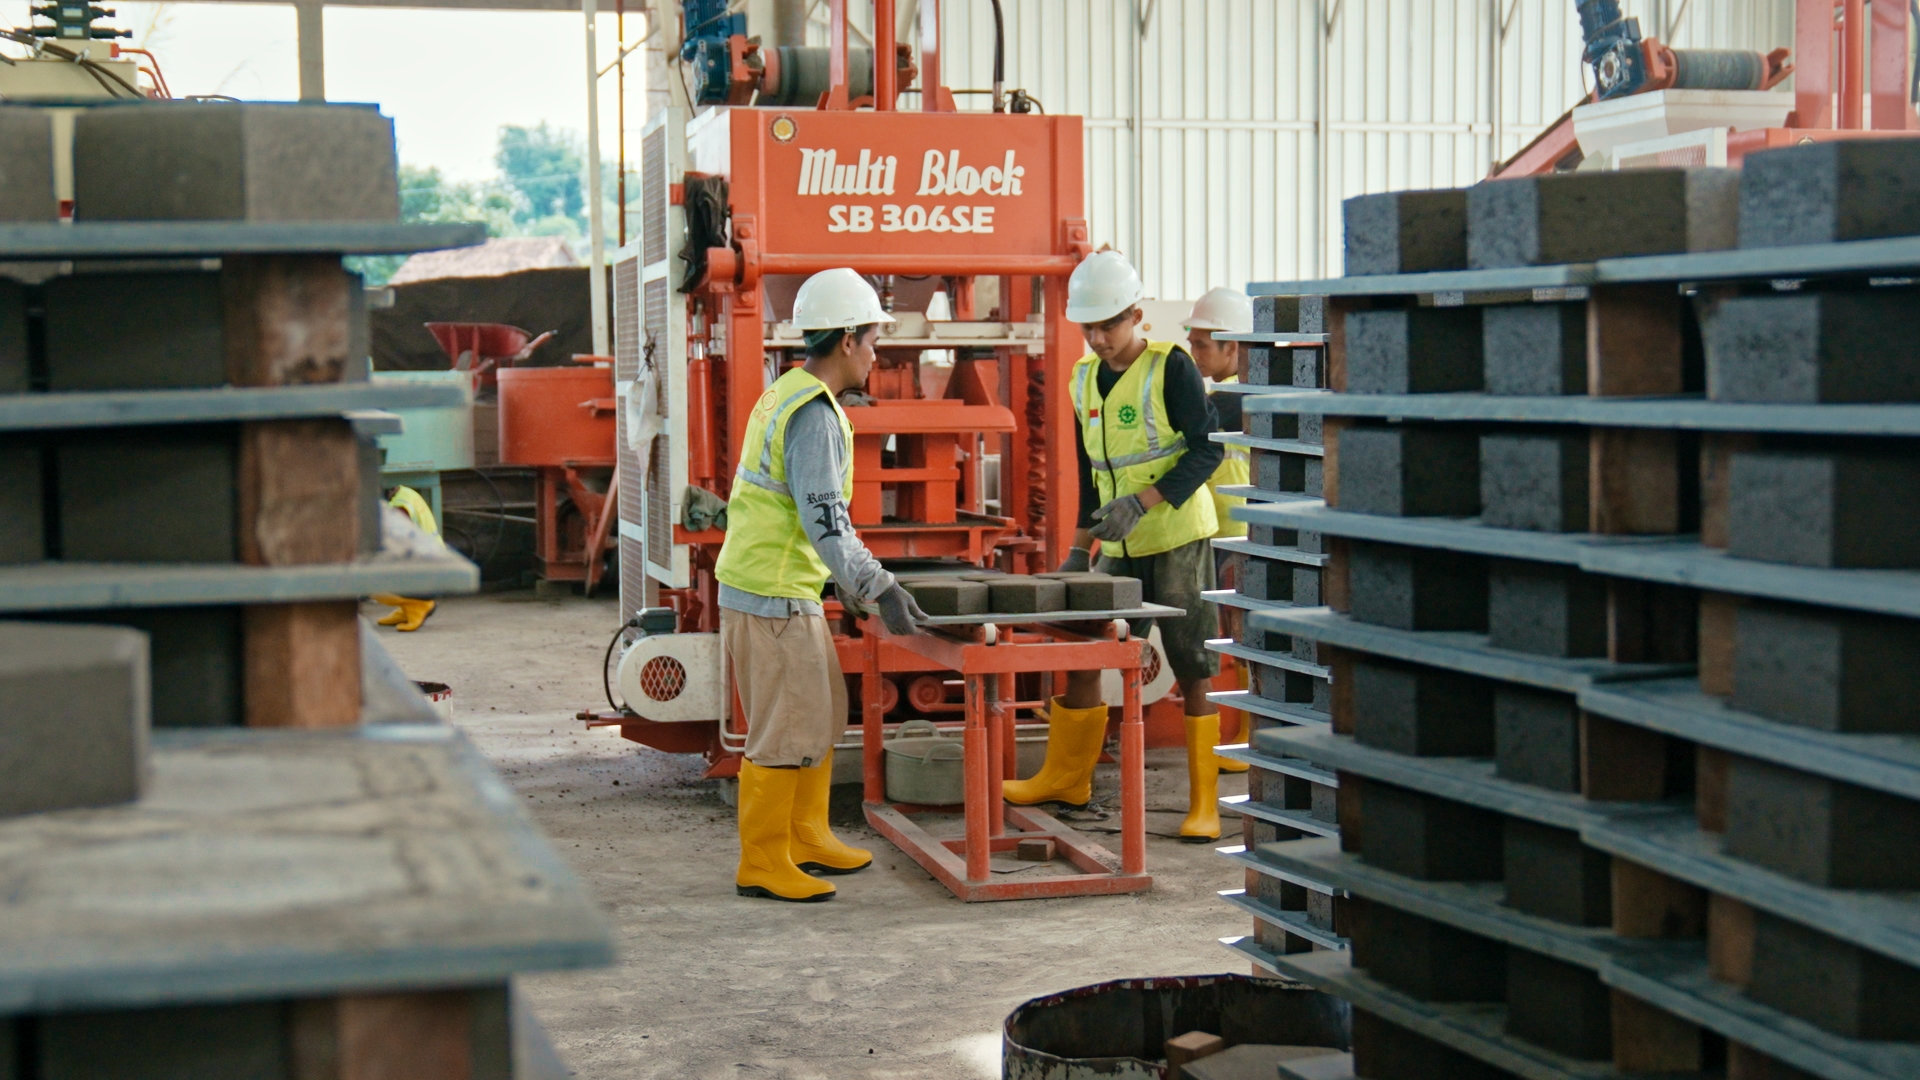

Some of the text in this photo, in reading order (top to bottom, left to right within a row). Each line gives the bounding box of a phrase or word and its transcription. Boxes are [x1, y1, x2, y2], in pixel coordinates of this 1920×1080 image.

[797, 148, 1025, 197] Multi Block
[827, 204, 995, 234] SB 306SE
[806, 490, 843, 505] Roose
